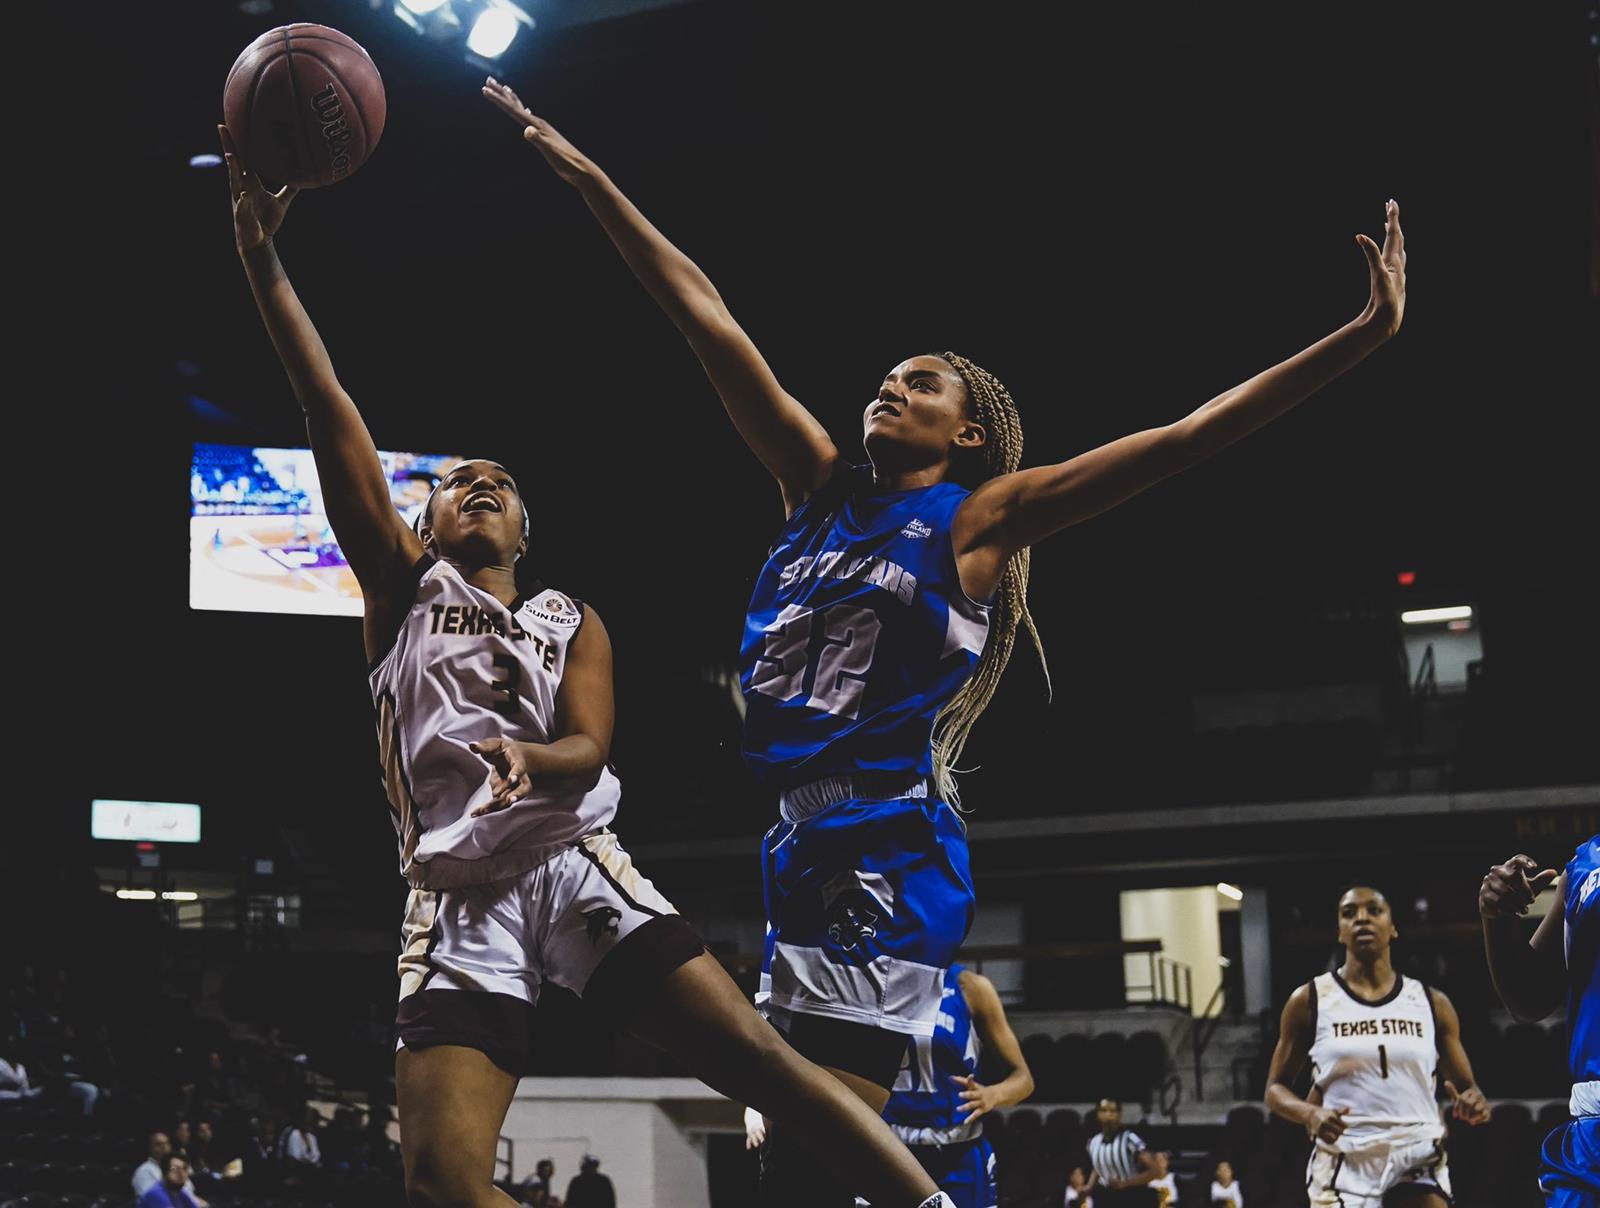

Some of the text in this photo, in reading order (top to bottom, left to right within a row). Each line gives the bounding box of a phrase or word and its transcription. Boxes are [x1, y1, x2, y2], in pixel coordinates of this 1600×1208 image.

[550, 614, 578, 625] BELT
[751, 602, 882, 721] 32
[492, 653, 521, 714] 3
[1332, 1018, 1424, 1038] TEXAS STATE
[1377, 1044, 1389, 1080] 1
